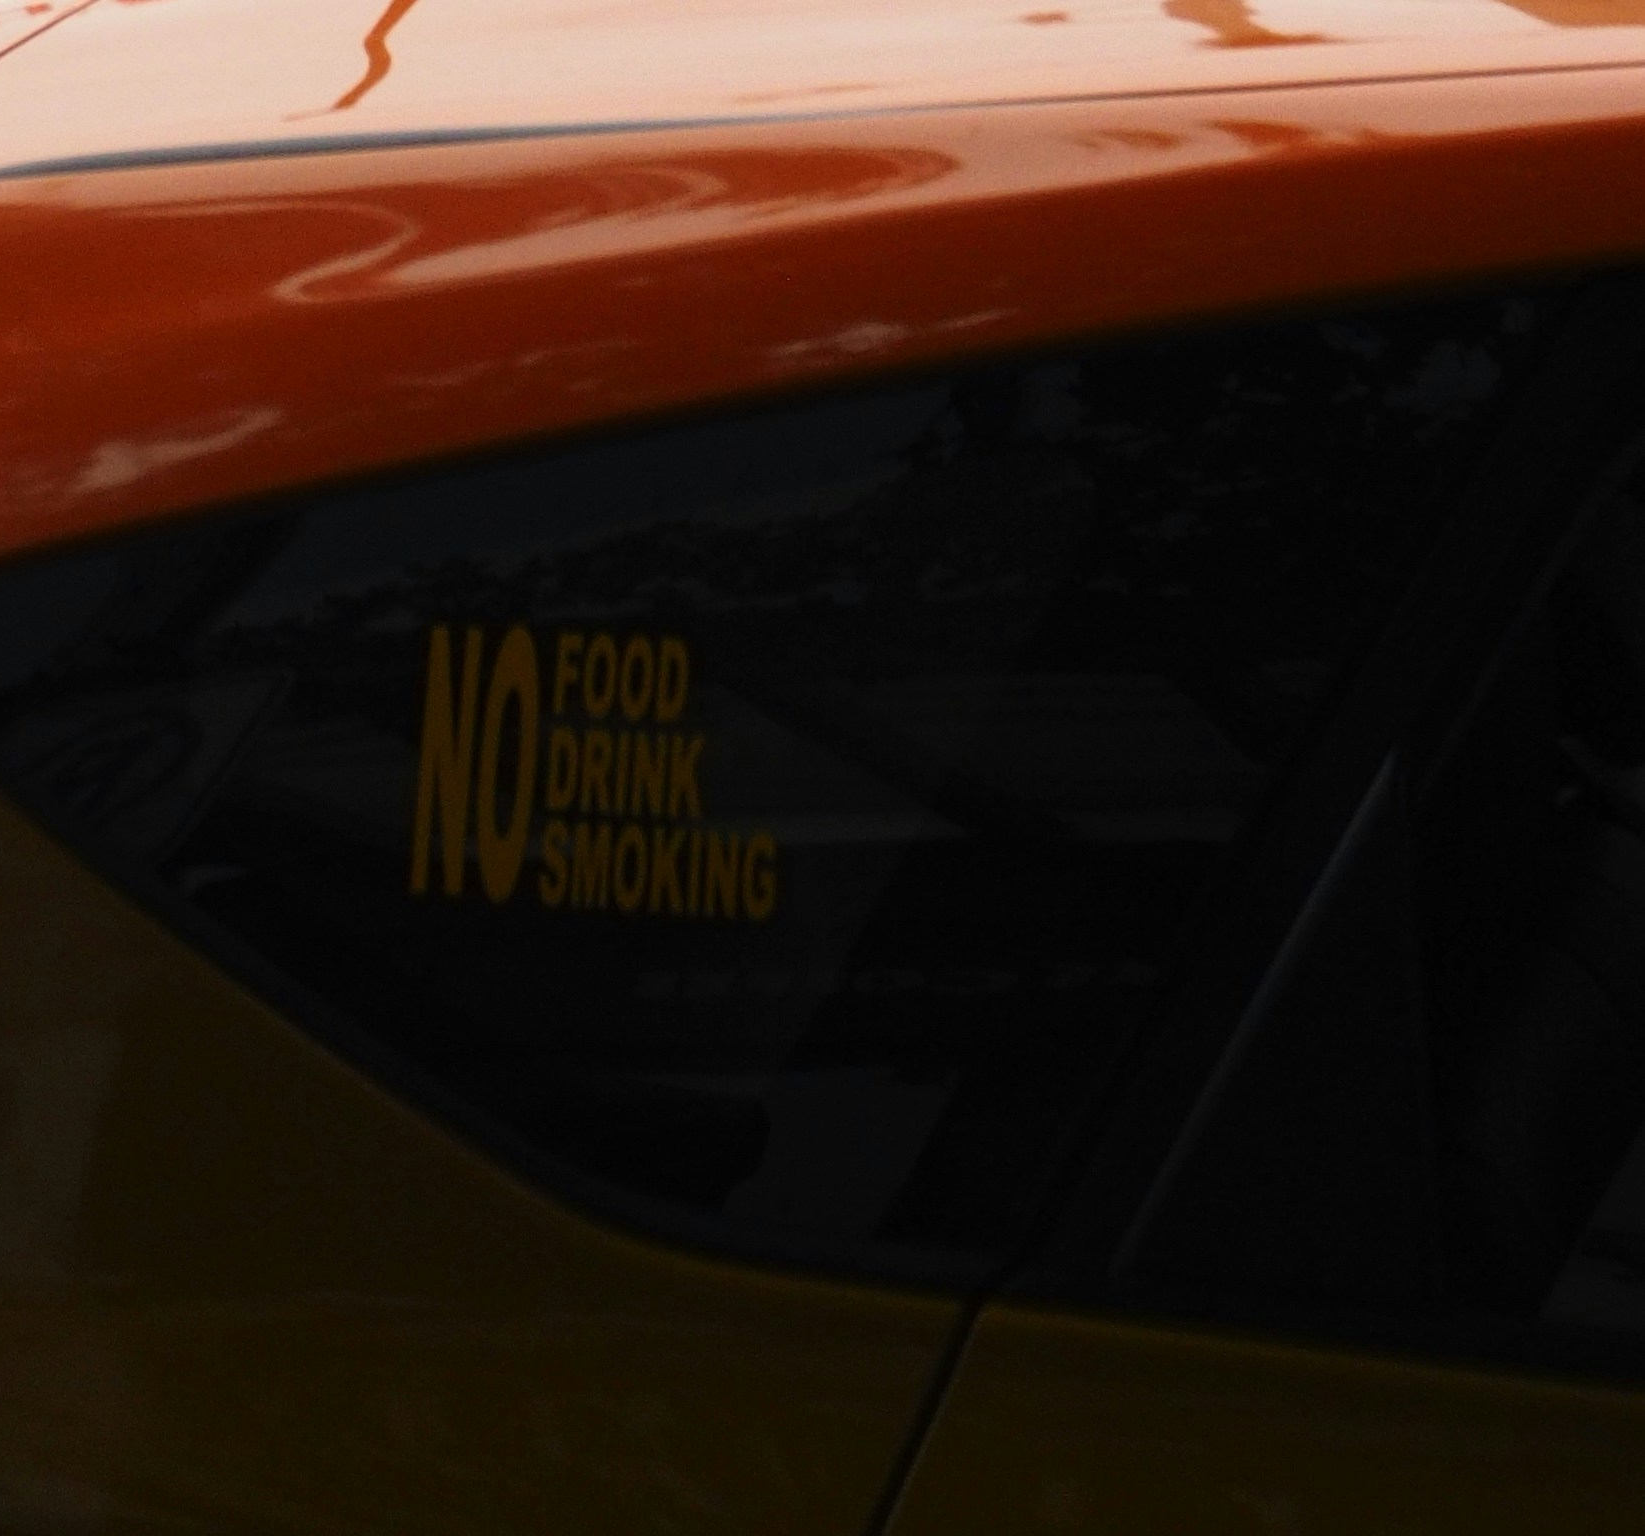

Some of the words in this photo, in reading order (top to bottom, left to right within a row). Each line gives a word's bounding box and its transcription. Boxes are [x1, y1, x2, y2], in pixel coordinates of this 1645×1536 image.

[410, 623, 540, 903] NO
[553, 630, 691, 721] FOOD
[545, 724, 704, 818] DRINK
[538, 819, 778, 921] SMOKING
